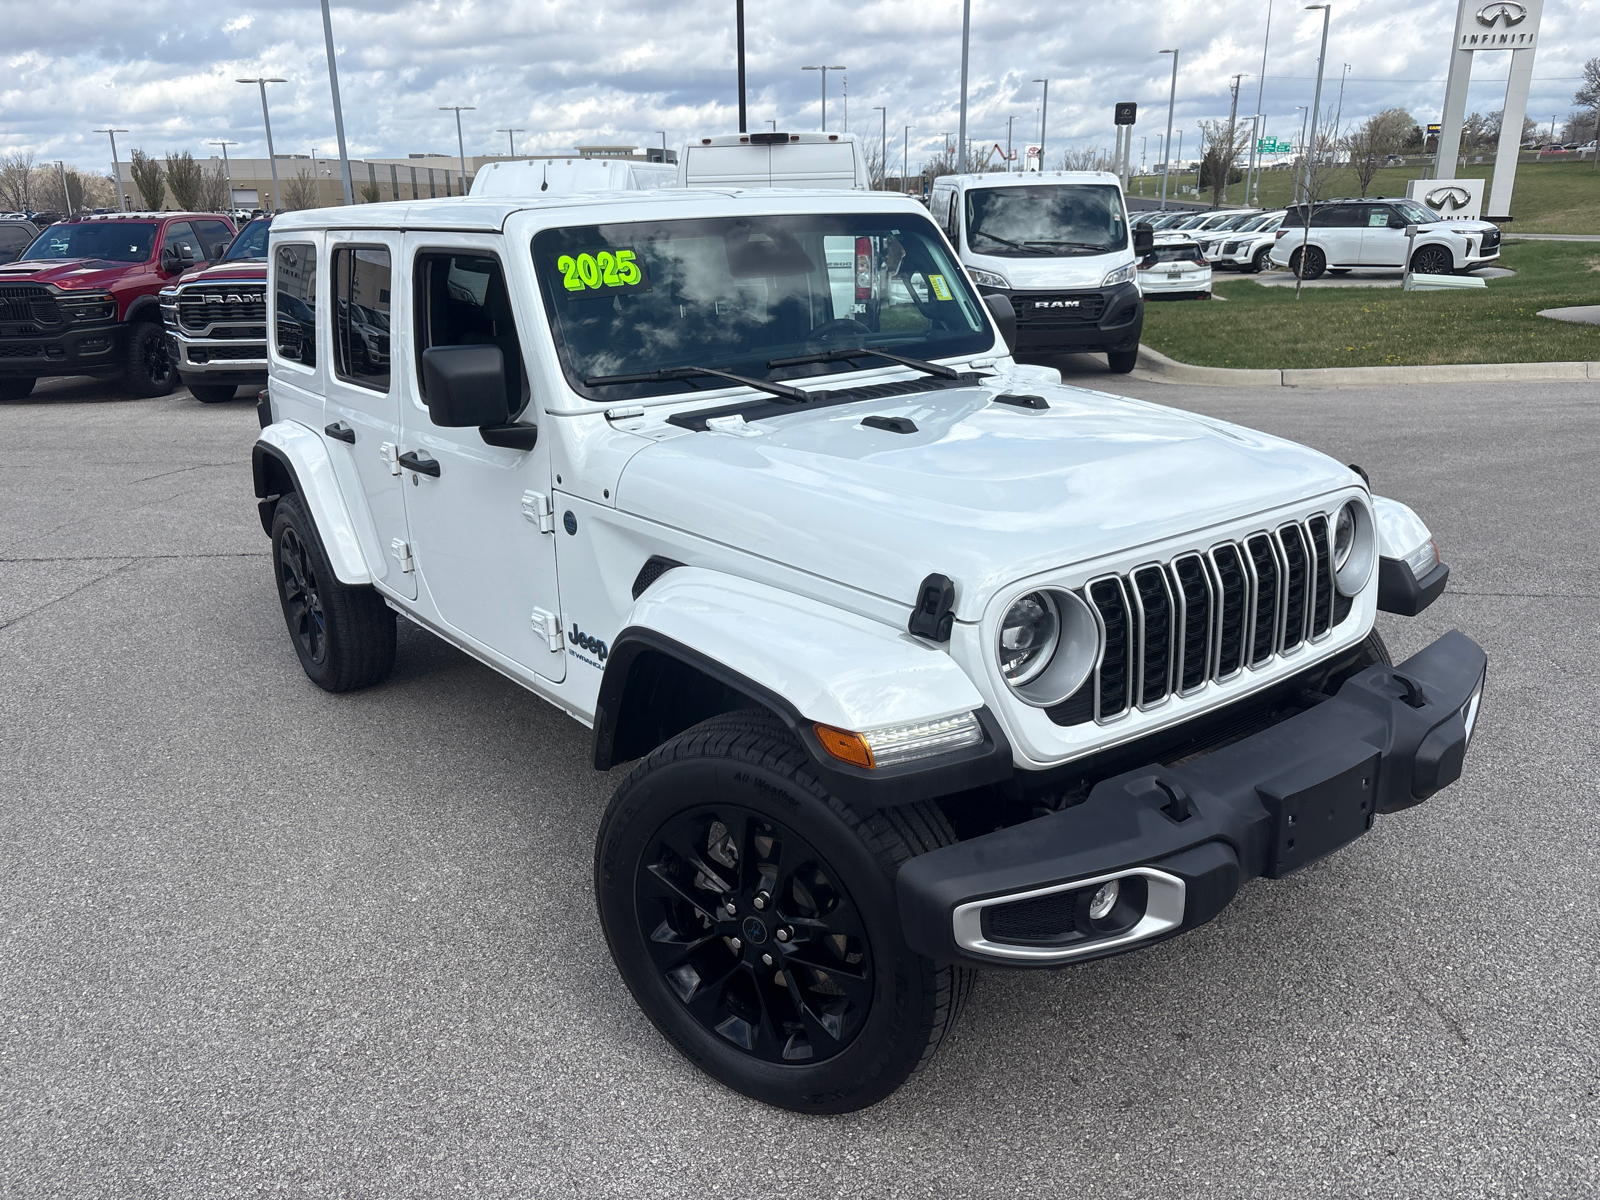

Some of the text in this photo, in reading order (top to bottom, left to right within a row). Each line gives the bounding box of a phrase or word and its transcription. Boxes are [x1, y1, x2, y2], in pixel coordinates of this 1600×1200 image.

[1462, 33, 1534, 44] INFINITI
[557, 250, 641, 291] 2025
[205, 293, 262, 303] RAM
[1034, 300, 1080, 308] RAM
[568, 622, 608, 662] Jeep
